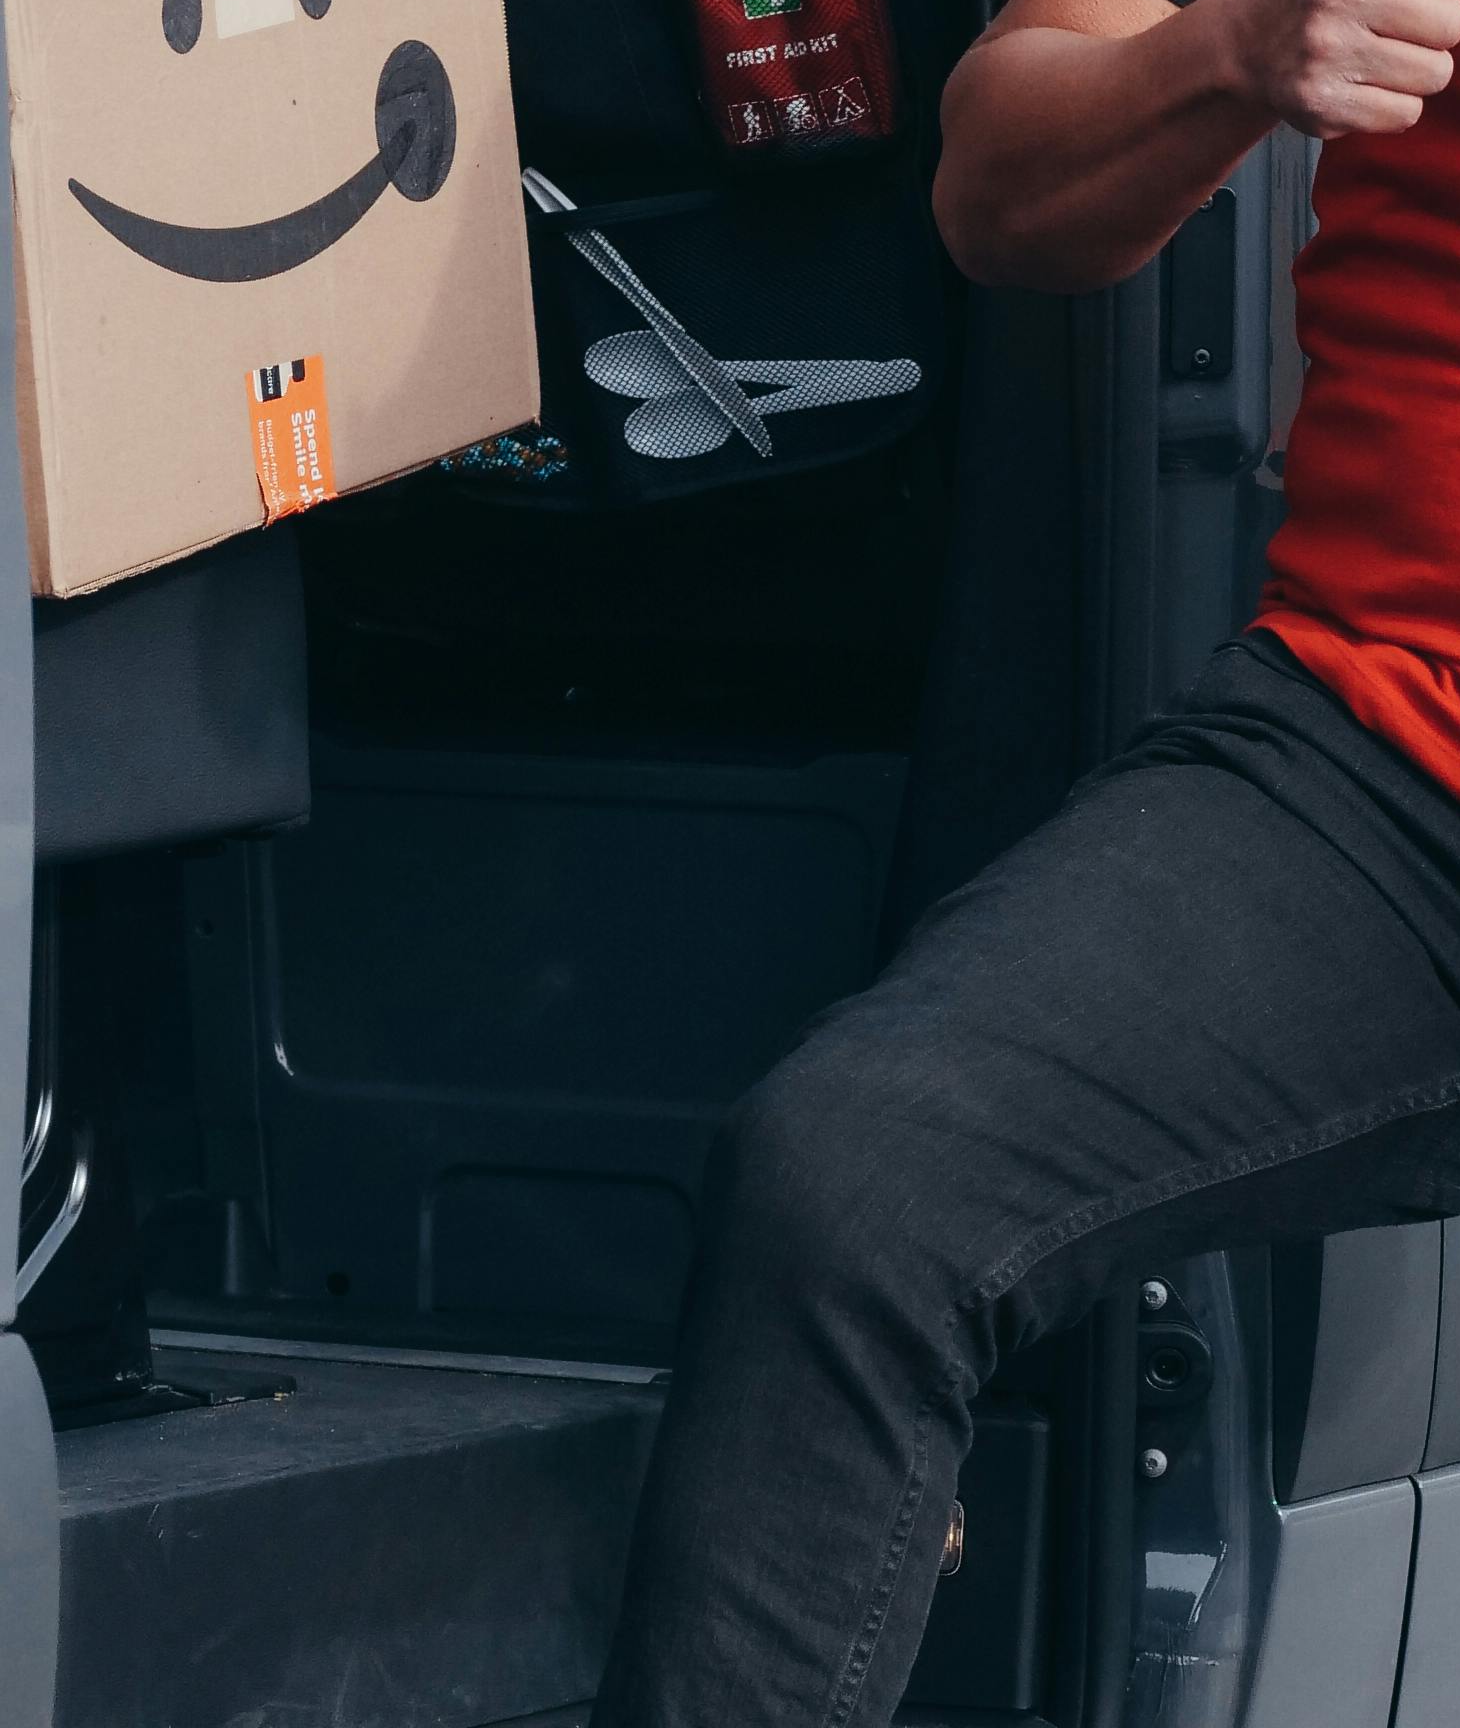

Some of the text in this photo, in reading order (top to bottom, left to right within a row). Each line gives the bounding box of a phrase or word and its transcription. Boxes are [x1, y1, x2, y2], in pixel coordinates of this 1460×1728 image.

[726, 33, 838, 68] FIRST AID KIT
[257, 421, 267, 459] brands
[291, 412, 306, 477] Smile
[304, 408, 323, 482] Spend
